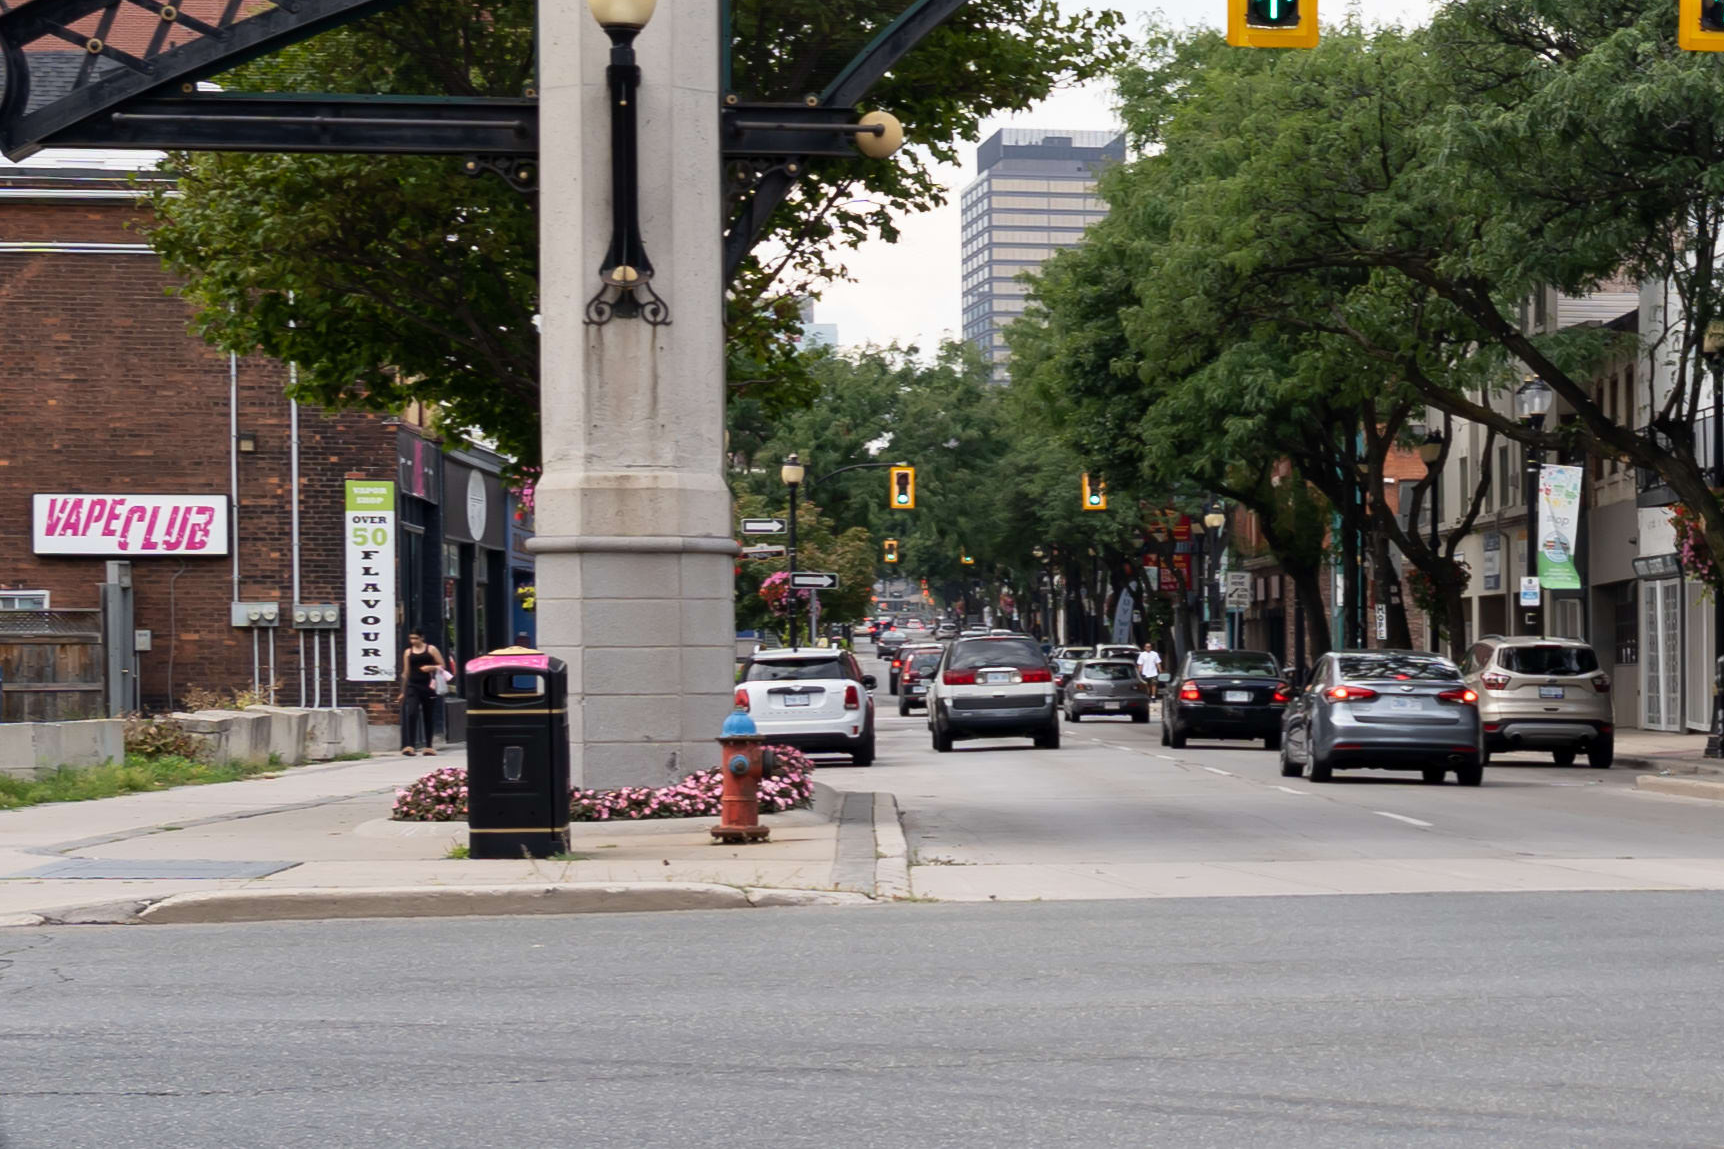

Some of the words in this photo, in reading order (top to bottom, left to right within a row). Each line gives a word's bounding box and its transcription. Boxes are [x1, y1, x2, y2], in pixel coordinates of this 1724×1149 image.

[352, 515, 388, 524] OVER
[352, 527, 388, 546] 50
[360, 550, 382, 676] FLAVOURS
